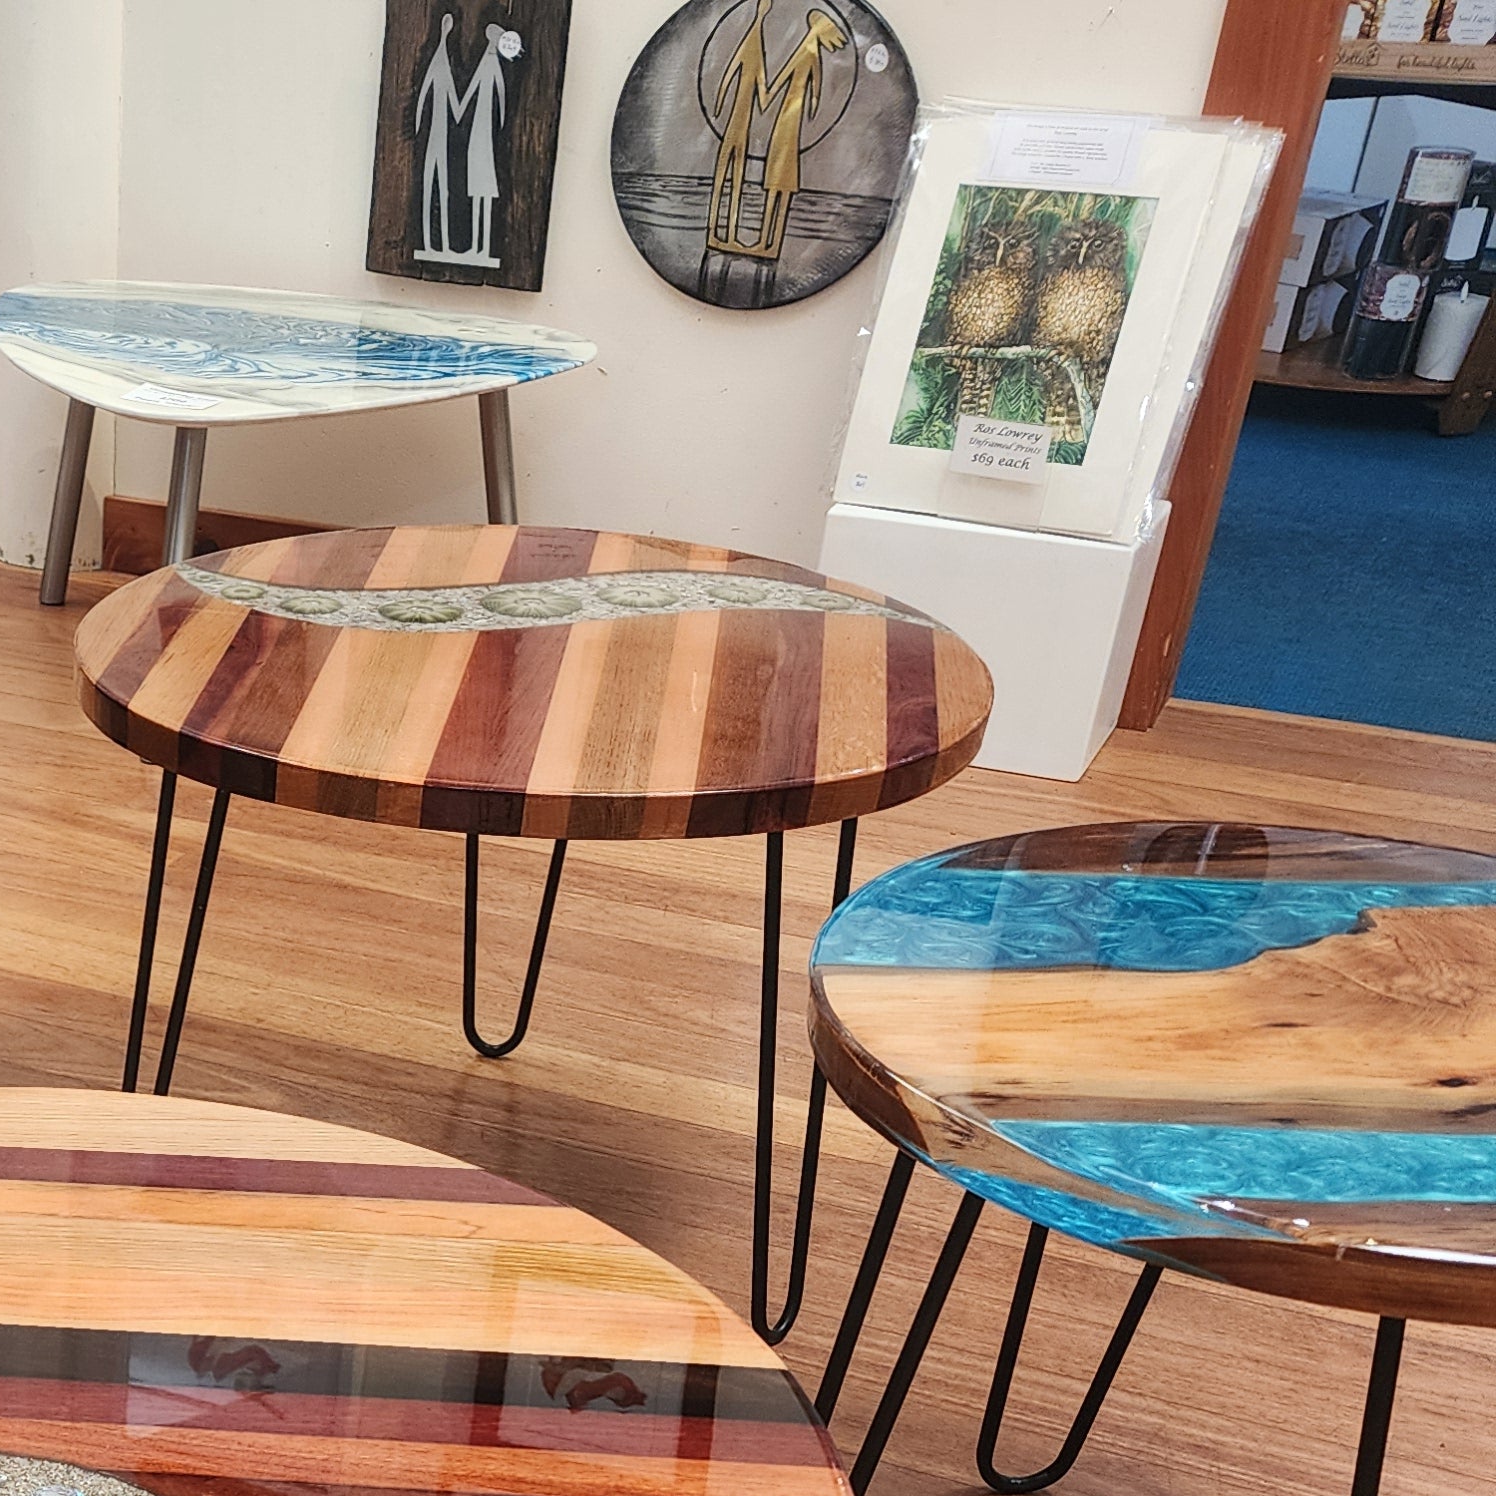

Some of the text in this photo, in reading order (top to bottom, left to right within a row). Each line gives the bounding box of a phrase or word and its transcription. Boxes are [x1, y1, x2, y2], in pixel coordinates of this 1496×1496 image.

[973, 423, 1043, 444] Ros Lowrey
[969, 437, 1042, 454] Unframed Prints
[971, 452, 1031, 470] $69 each
